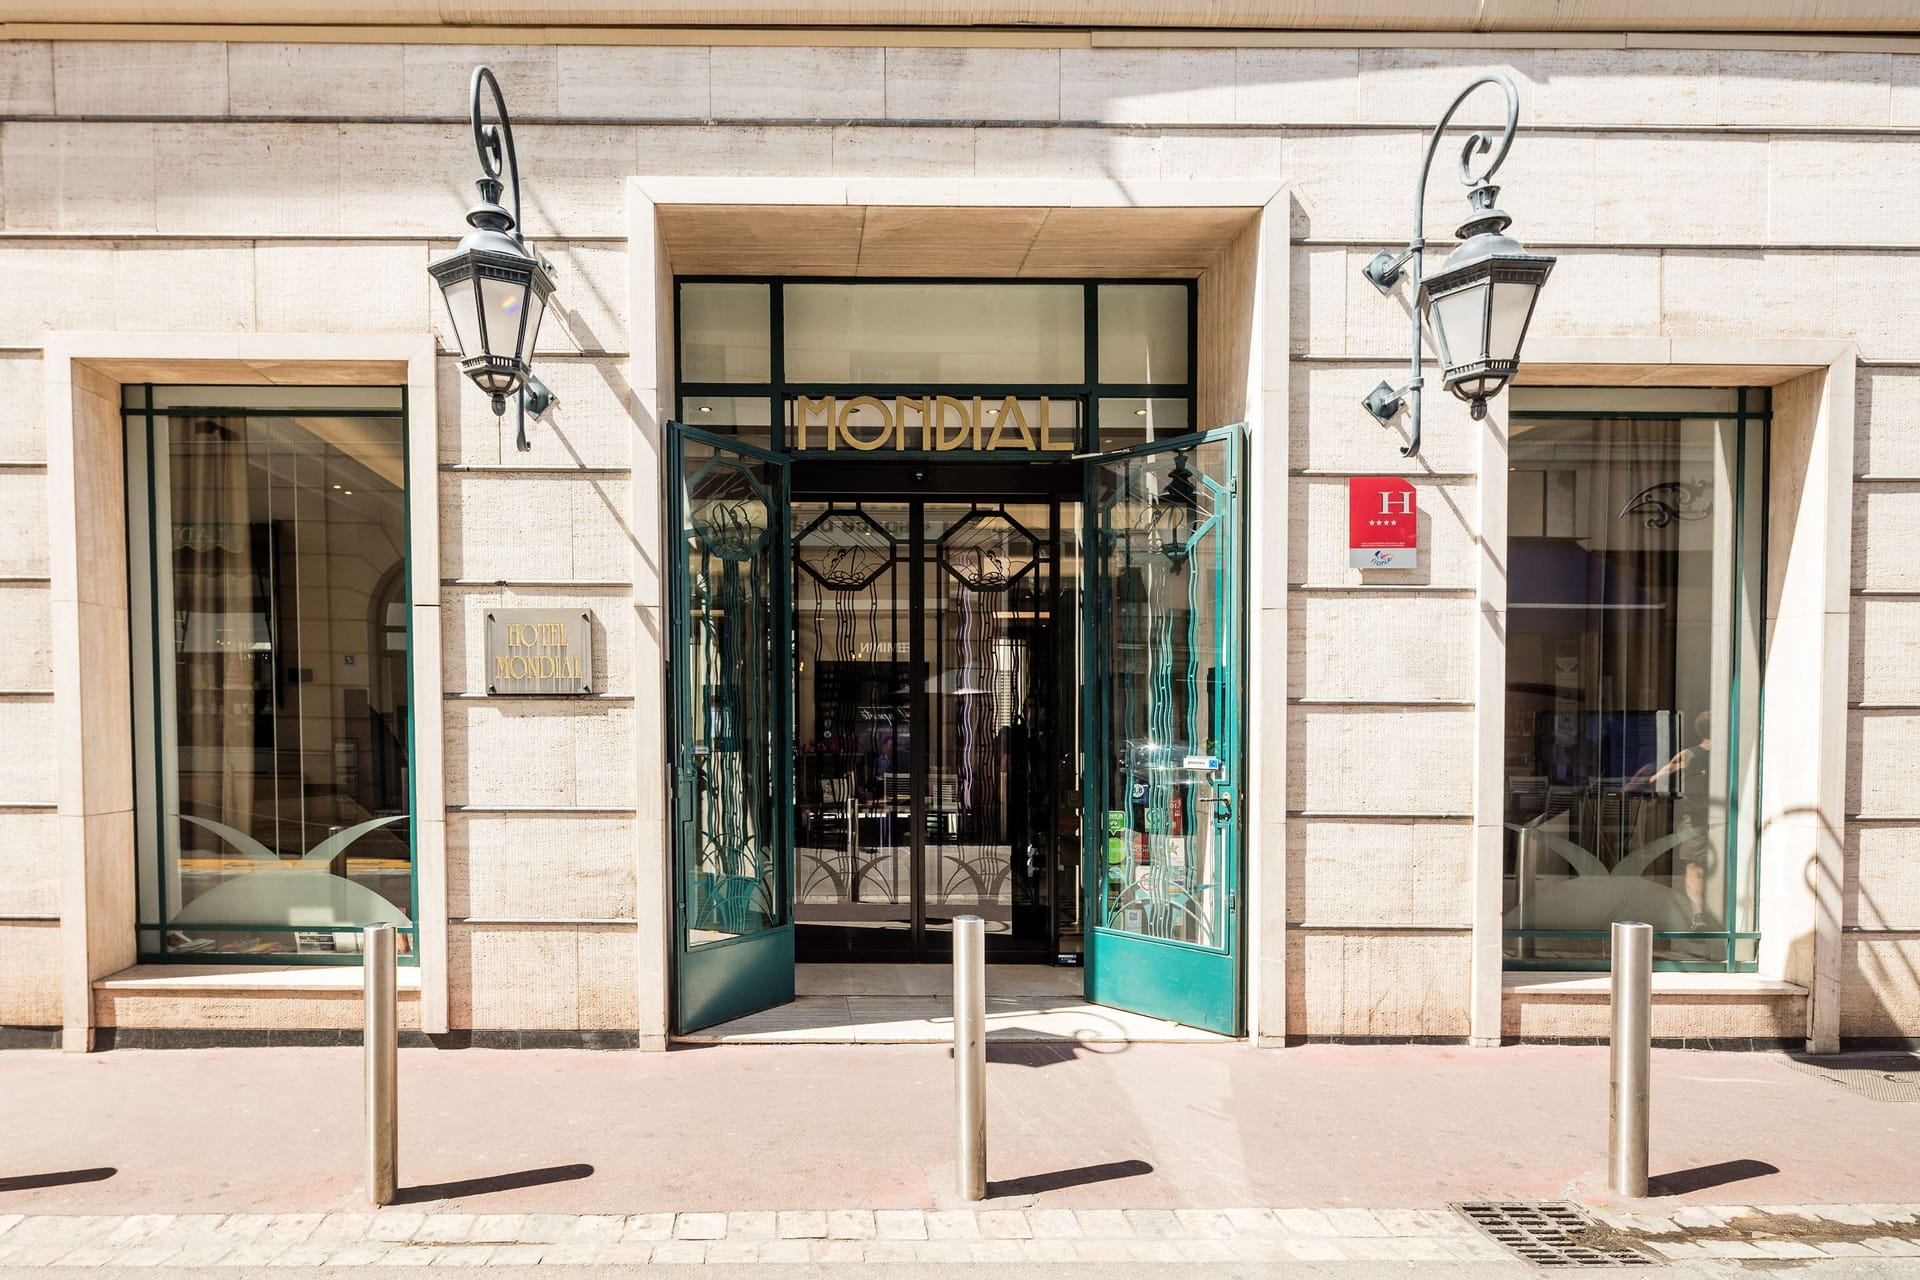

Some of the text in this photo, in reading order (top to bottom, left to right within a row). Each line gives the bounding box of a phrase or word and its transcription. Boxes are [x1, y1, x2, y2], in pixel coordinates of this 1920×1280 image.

[797, 395, 1075, 451] MONDIAL
[1378, 491, 1415, 515] H
[508, 624, 567, 647] HOTEL
[495, 656, 582, 679] MONDIAL
